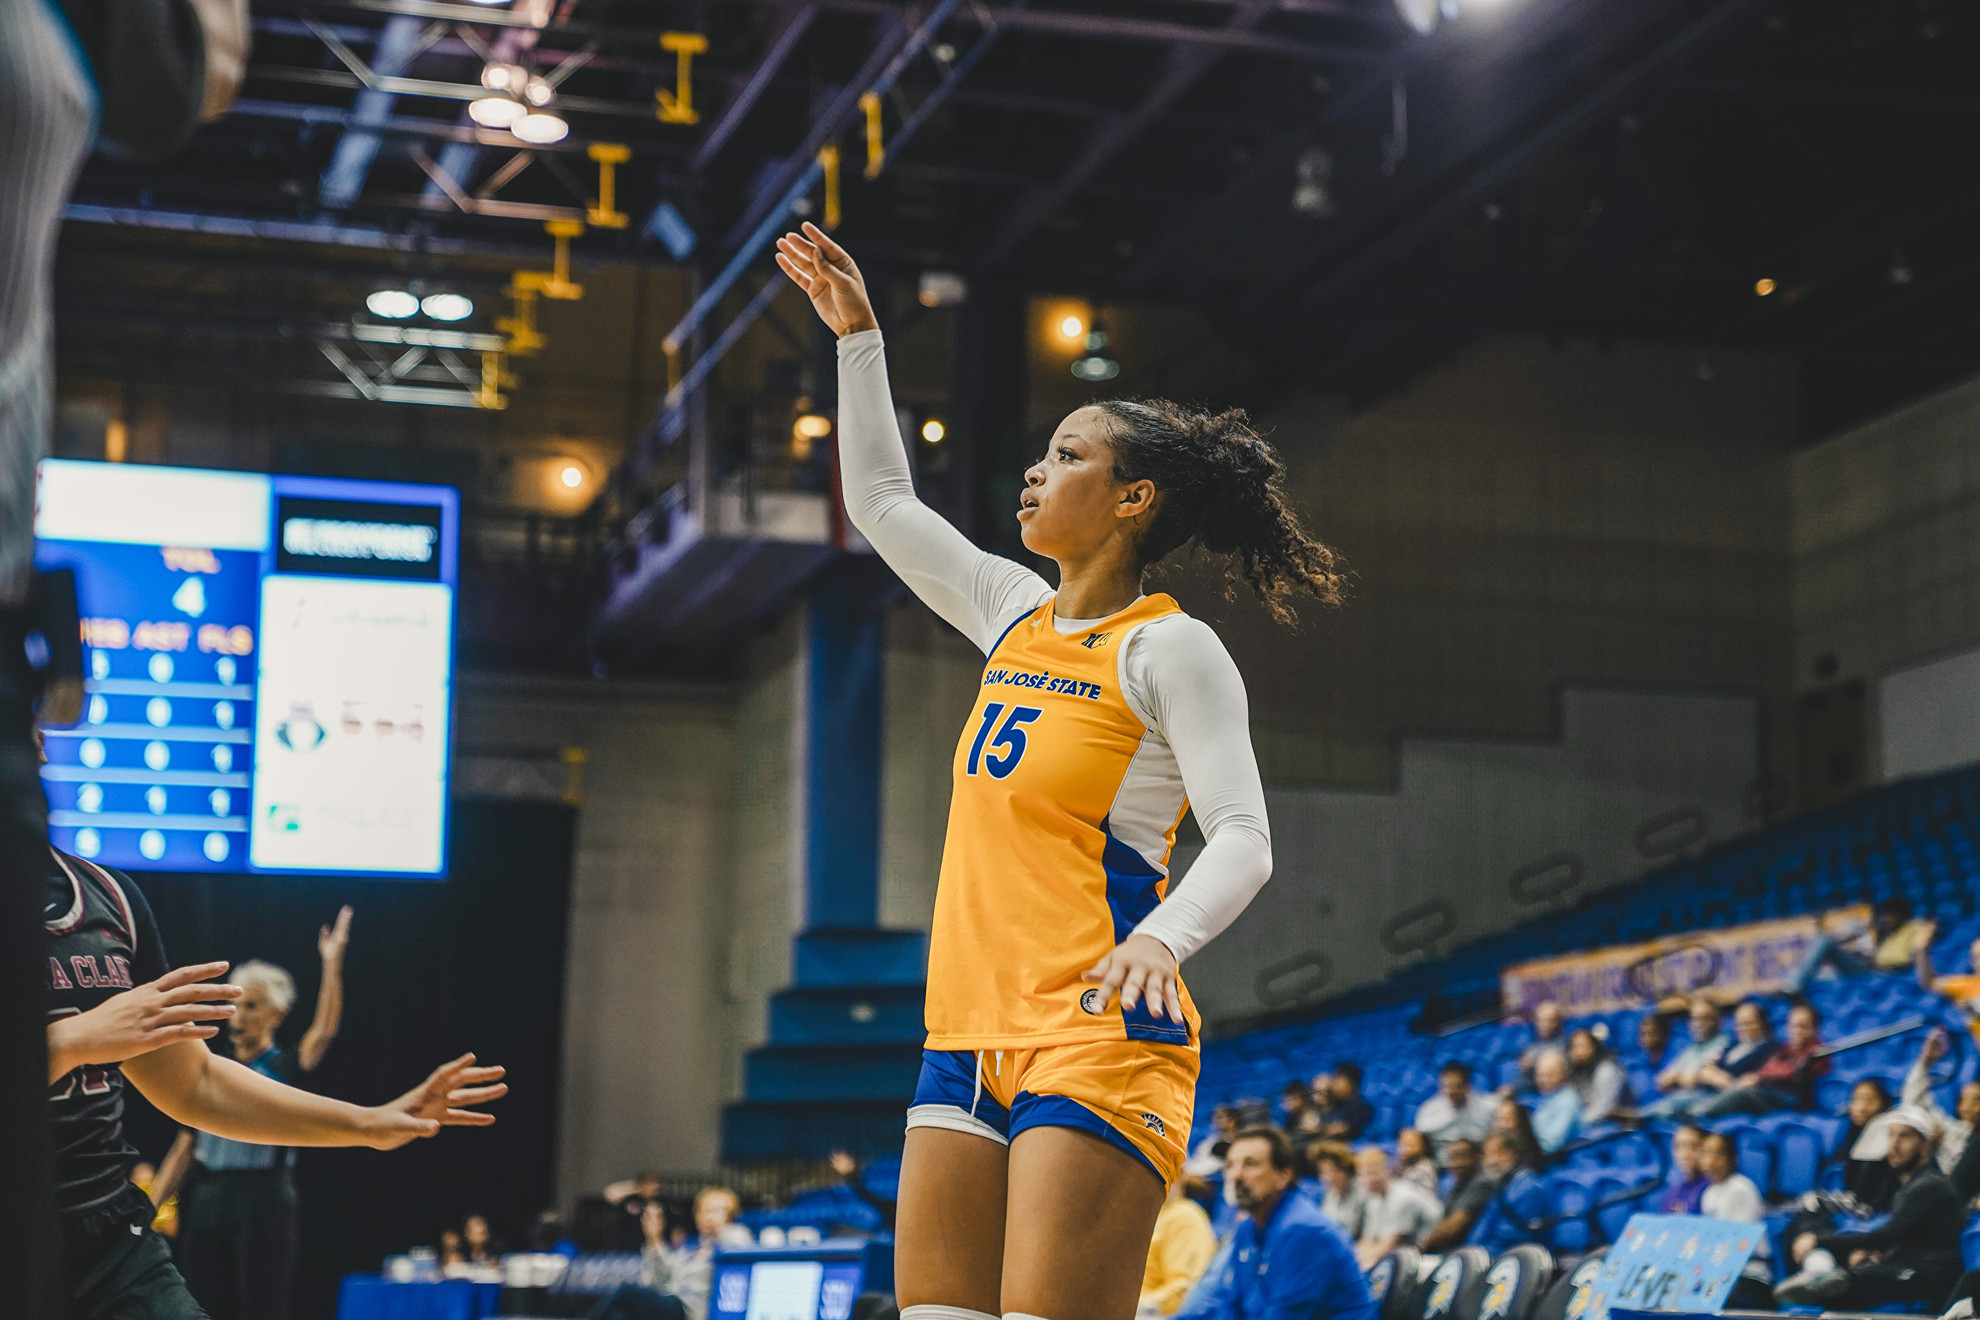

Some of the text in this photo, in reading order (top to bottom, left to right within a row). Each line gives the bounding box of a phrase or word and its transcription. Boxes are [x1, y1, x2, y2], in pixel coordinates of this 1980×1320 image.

[172, 576, 207, 618] 4
[984, 669, 1102, 700] SAN JOSÉ STATE
[966, 701, 1045, 781] 15
